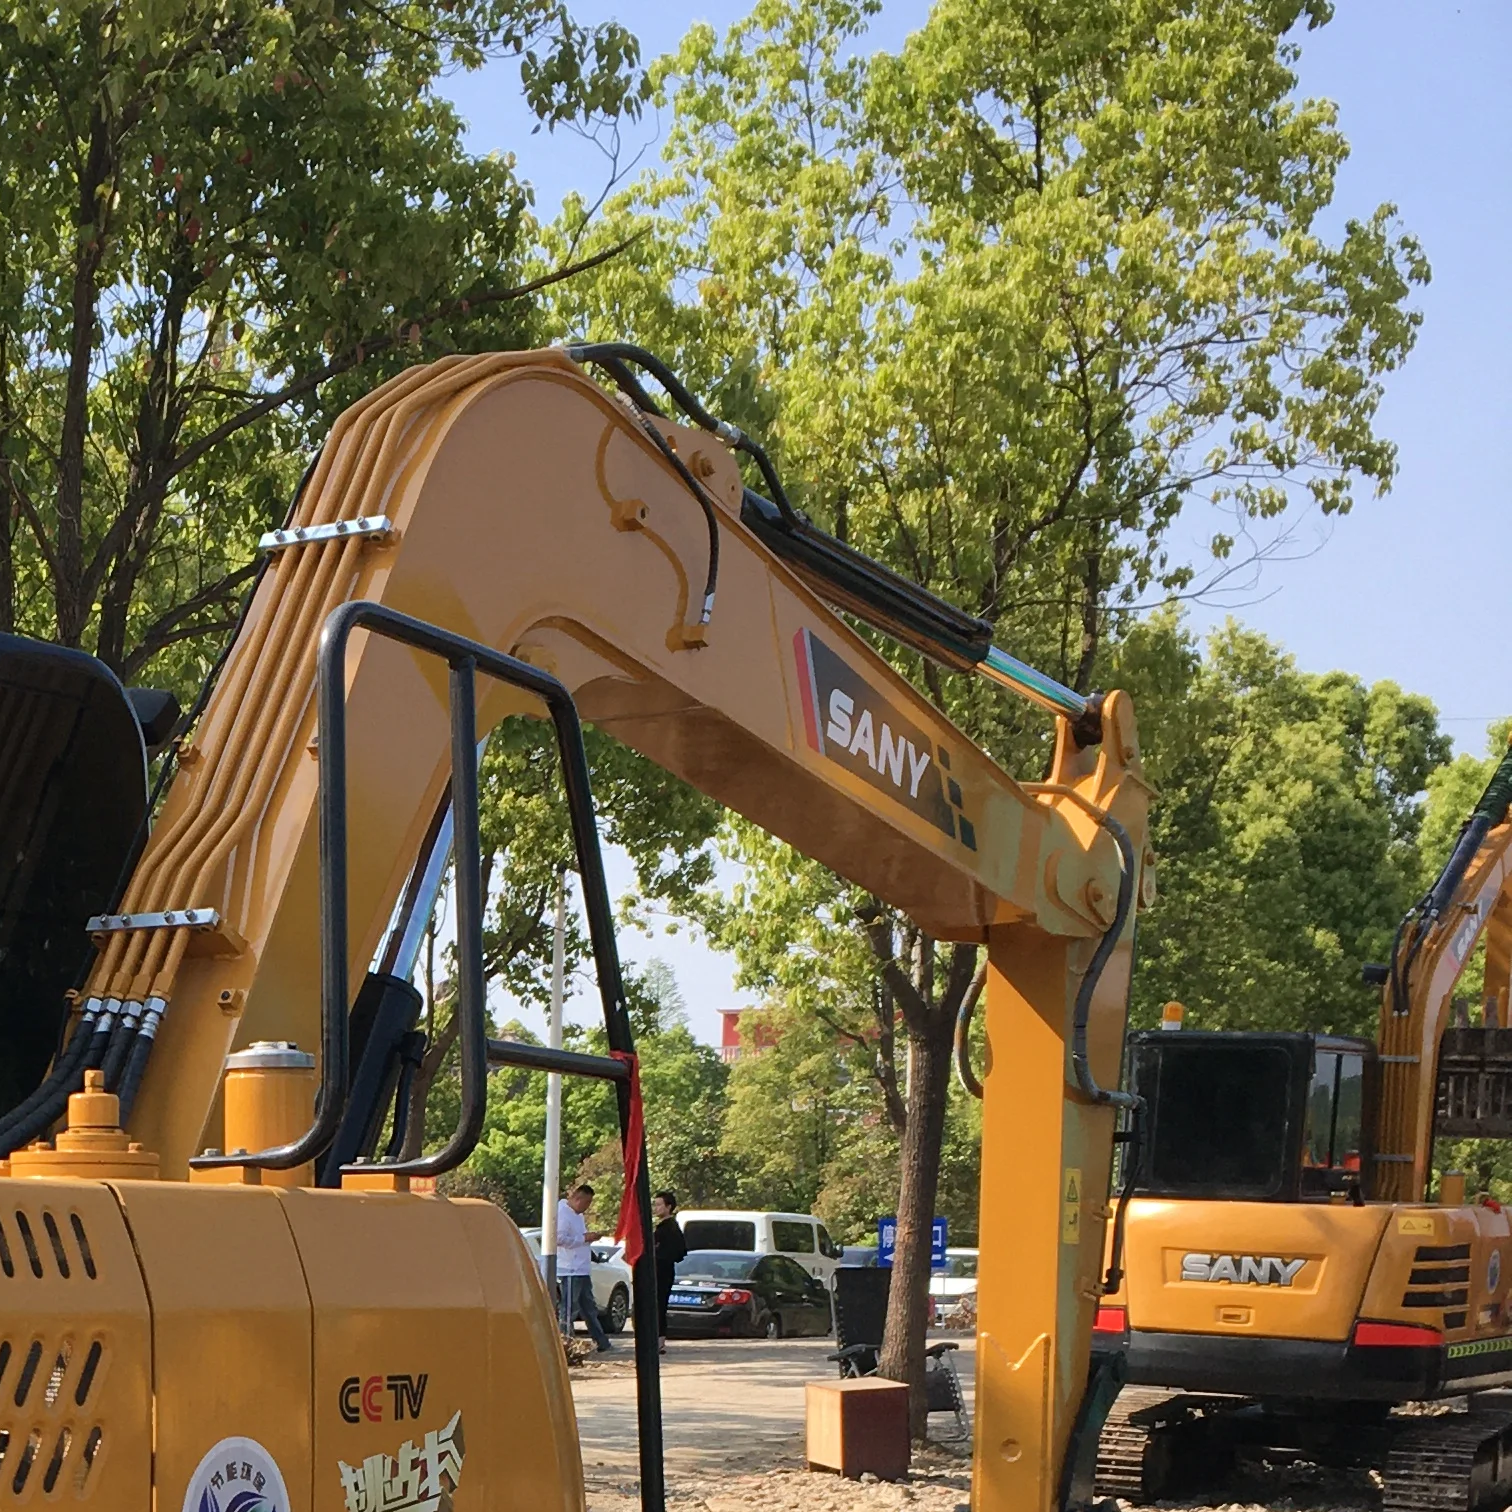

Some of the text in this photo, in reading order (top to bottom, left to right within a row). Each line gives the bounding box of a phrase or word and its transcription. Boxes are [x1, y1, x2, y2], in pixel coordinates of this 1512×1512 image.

[827, 688, 930, 799] SANY
[1181, 1252, 1308, 1287] SANY
[338, 1373, 428, 1424] CCTV
[210, 1461, 267, 1492] 节能环保
